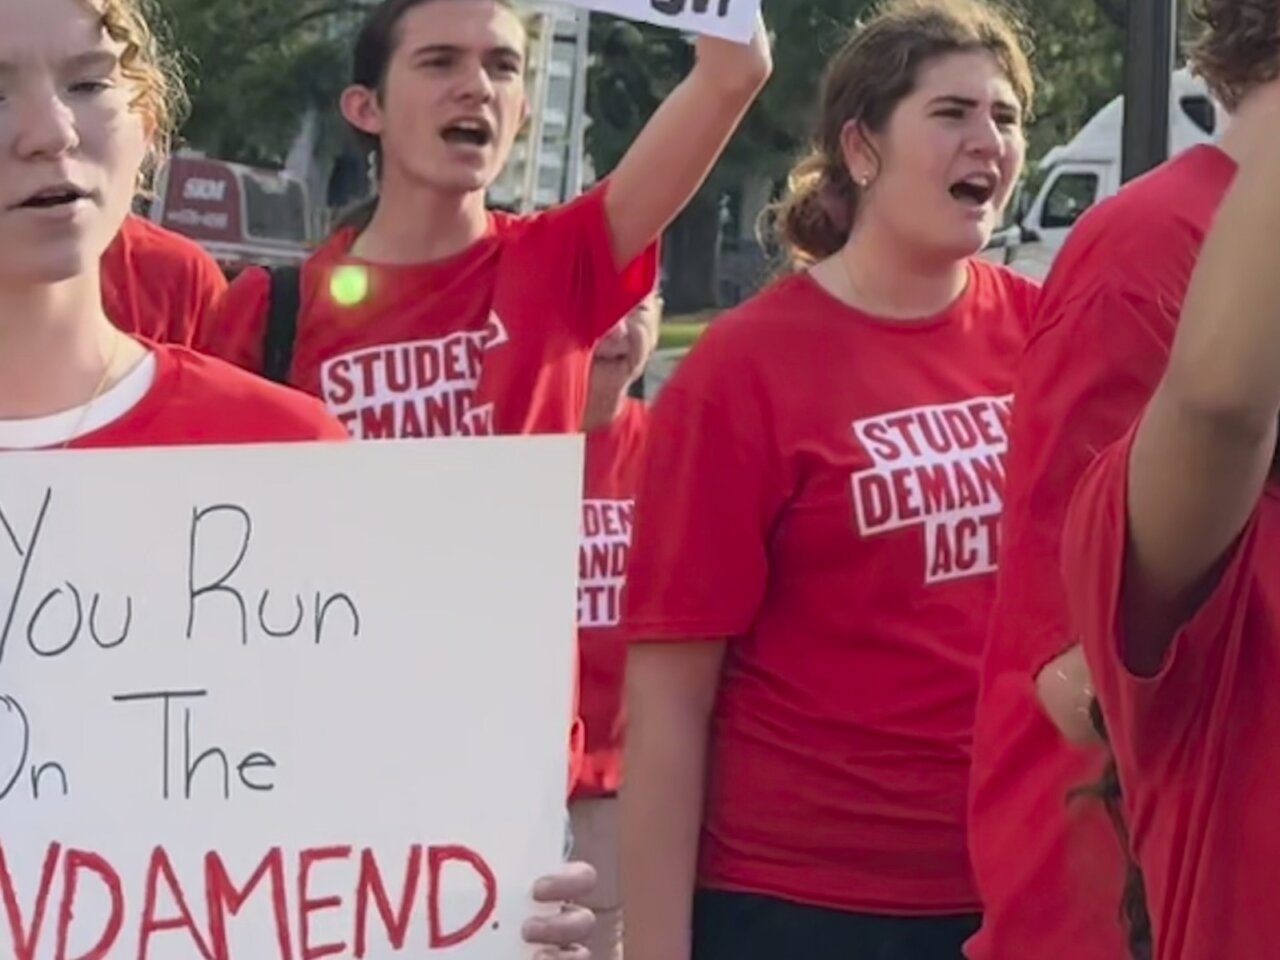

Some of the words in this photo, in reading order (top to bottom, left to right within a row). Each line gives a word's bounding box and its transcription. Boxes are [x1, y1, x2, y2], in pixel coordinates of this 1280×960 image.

[0, 488, 132, 662] You
[187, 504, 360, 645] Run
[113, 690, 277, 800] The
